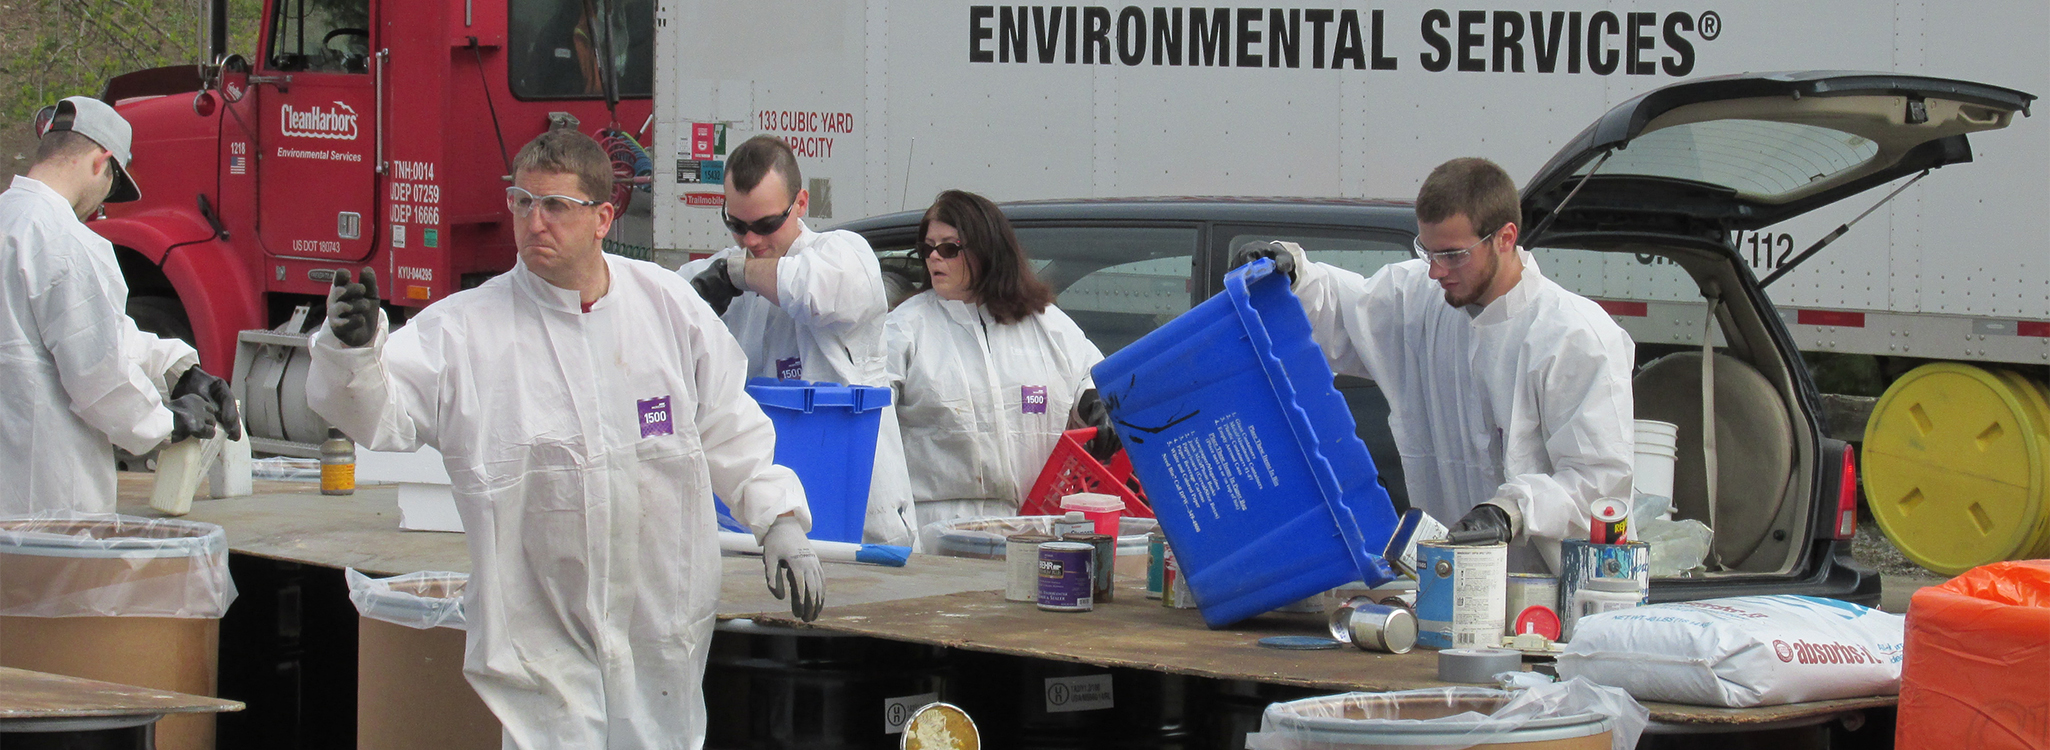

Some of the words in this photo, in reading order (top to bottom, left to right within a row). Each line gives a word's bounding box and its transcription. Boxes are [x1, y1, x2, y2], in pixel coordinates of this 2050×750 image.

[969, 5, 1398, 71] ENVIRONMENTAL
[281, 103, 358, 140] CleanHarbors
[758, 110, 777, 131] 133
[780, 110, 818, 132] CUBIC
[821, 112, 853, 133] YARD
[230, 142, 246, 155] 1218
[277, 147, 328, 160] Environmental
[330, 151, 362, 162] Services
[776, 135, 834, 158] PACITY
[394, 160, 434, 180] TNH-0014
[413, 184, 440, 203] 07259
[687, 194, 725, 206] Trailmobile
[414, 205, 440, 225] 16666
[292, 240, 302, 251] US
[303, 240, 318, 251] DOT
[782, 367, 801, 379] 1500
[1026, 395, 1044, 404] 1500
[644, 410, 667, 424] 1500
